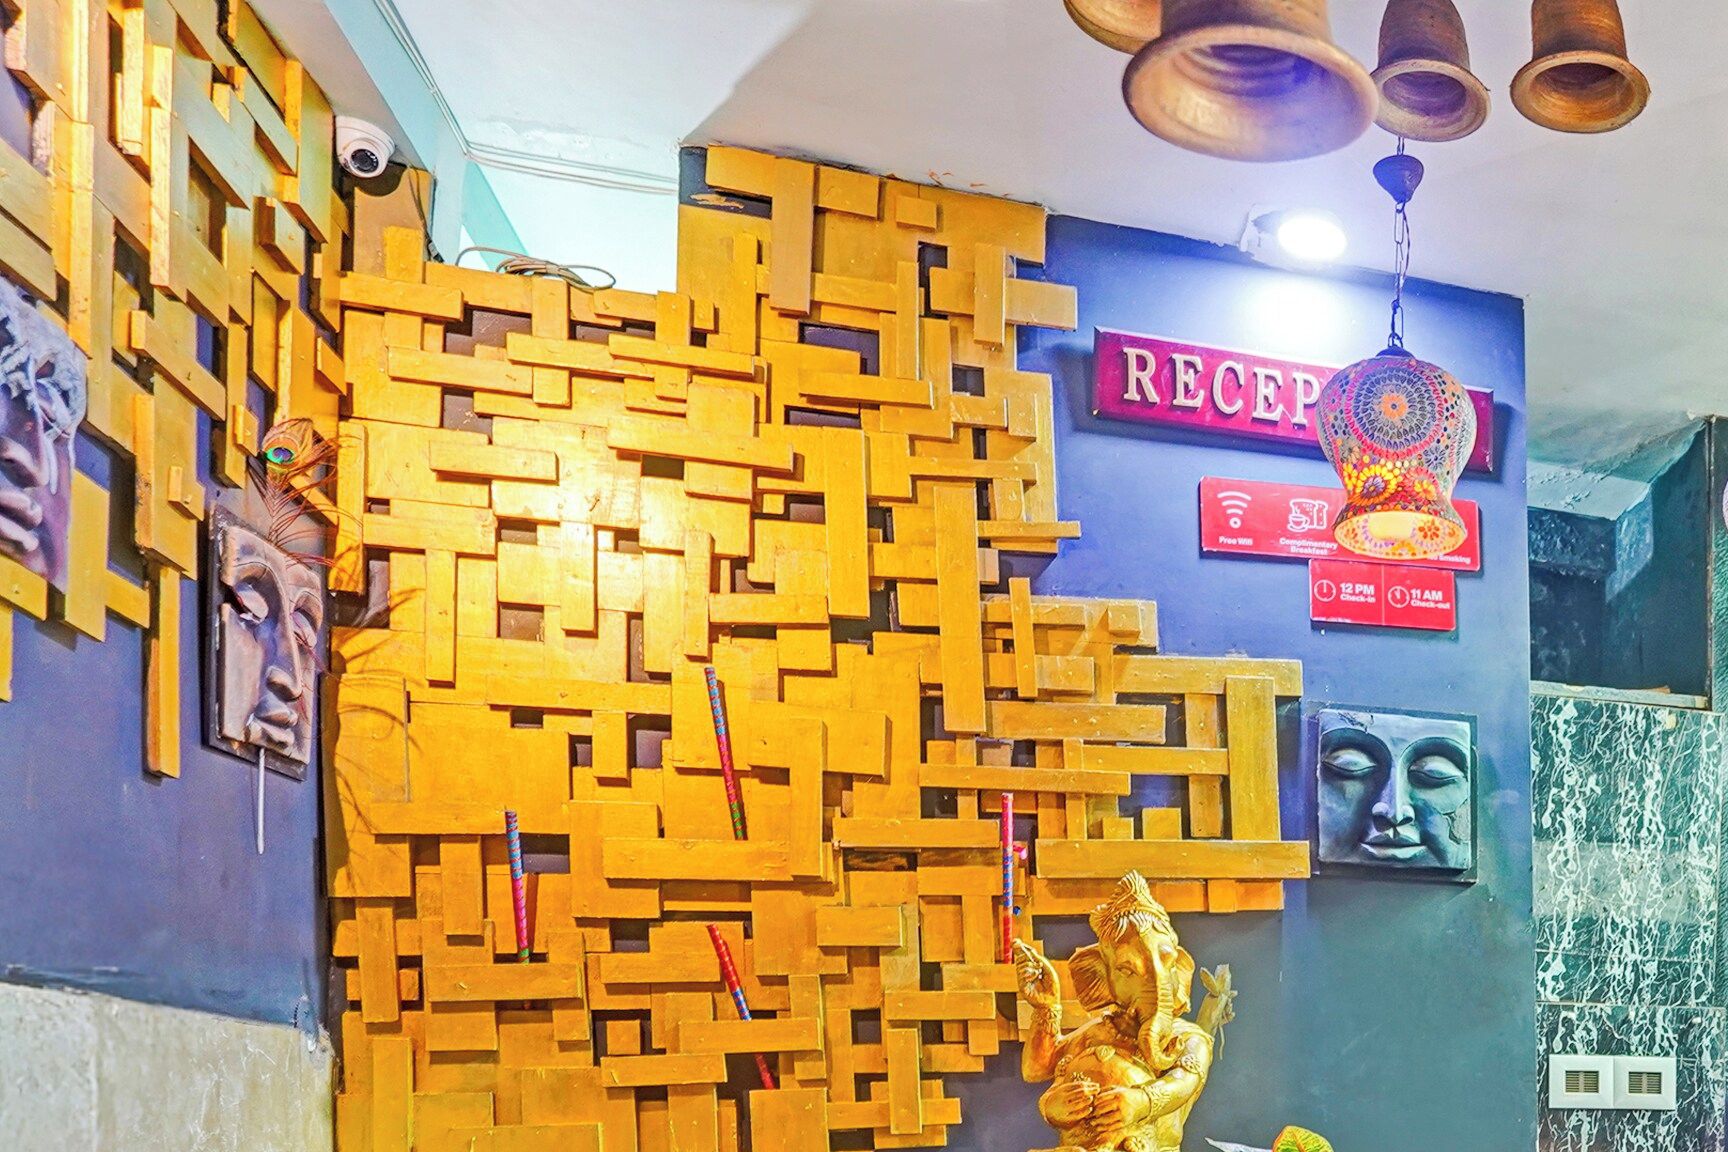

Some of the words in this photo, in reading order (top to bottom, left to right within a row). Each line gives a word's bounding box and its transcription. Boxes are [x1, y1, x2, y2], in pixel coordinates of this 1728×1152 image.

[1123, 347, 1321, 425] RECEP
[1219, 535, 1237, 545] Free
[1279, 537, 1338, 549] Complimentary
[1290, 546, 1328, 555] Breakfast
[1438, 555, 1471, 565] Smoking
[1340, 582, 1352, 594] 12
[1355, 584, 1374, 595] PM
[1340, 593, 1376, 603] Check-in
[1411, 589, 1420, 599] 11
[1423, 590, 1442, 601] AM
[1411, 601, 1450, 610] Check-out
